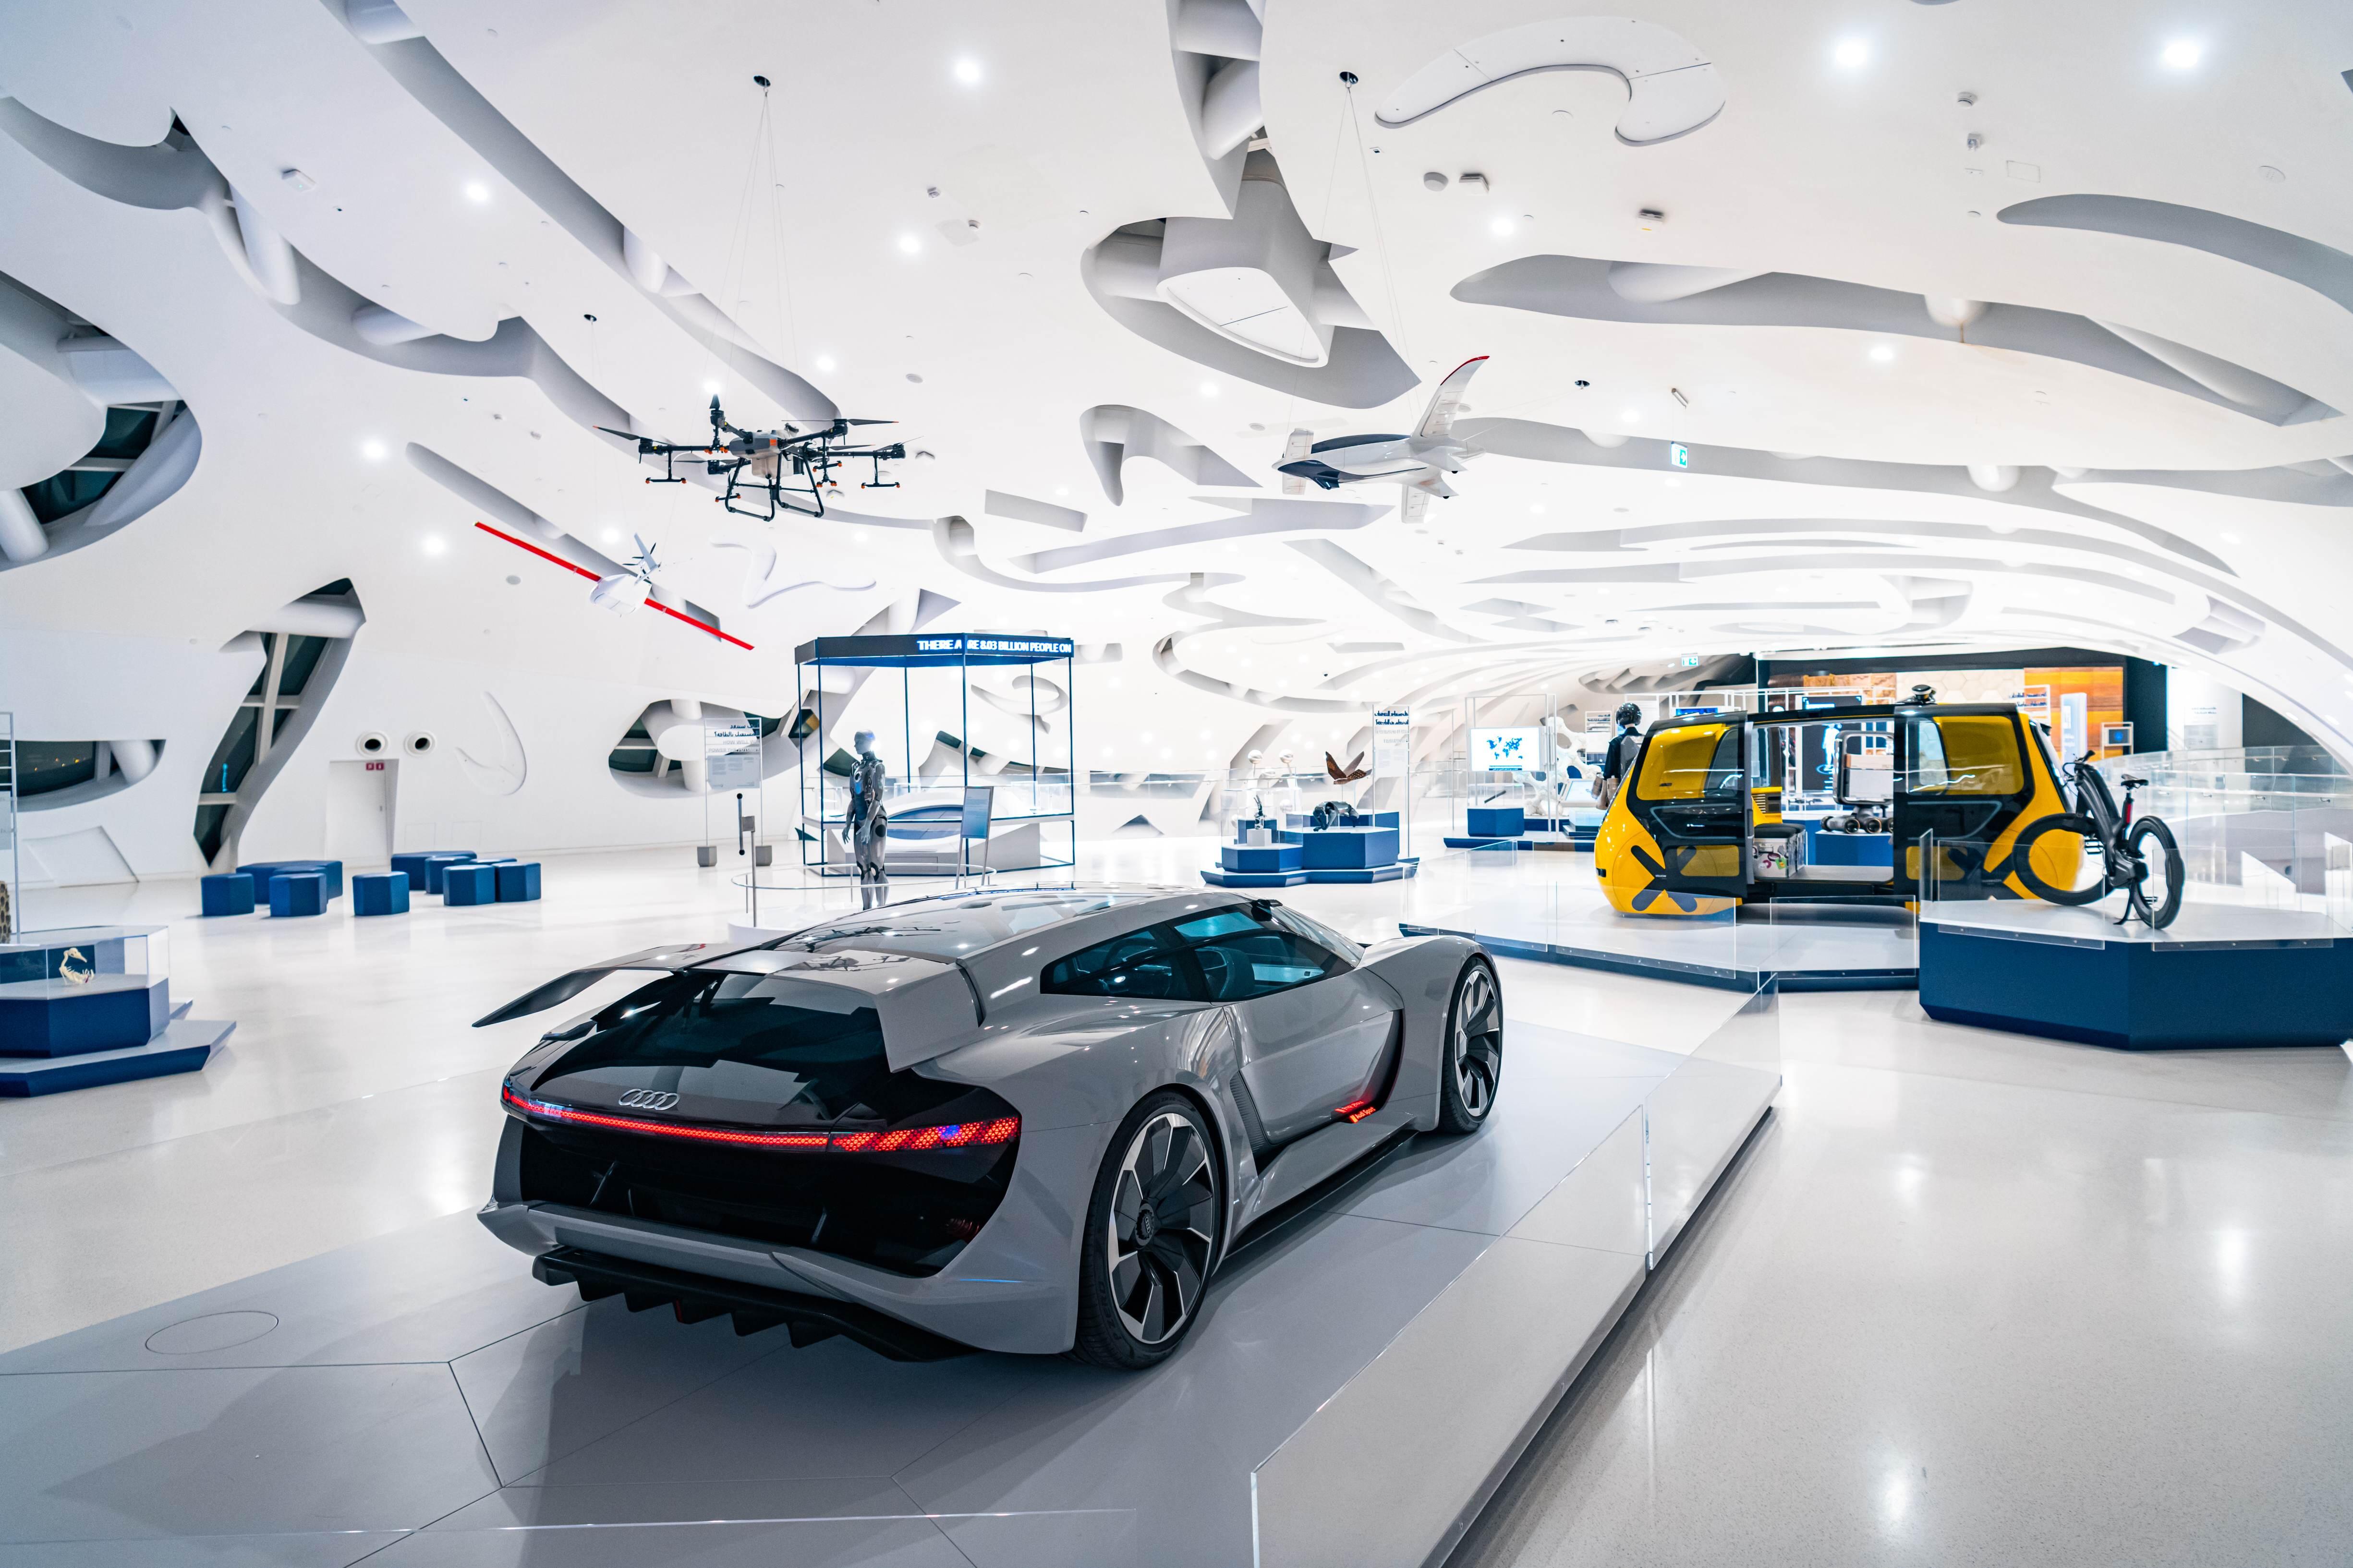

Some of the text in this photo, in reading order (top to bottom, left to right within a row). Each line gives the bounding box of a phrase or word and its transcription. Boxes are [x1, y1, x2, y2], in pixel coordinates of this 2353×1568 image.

[917, 639, 954, 651] THERE
[998, 640, 1030, 652] BILLION
[1030, 641, 1059, 653] PEOPLE
[1059, 643, 1072, 653] ON
[1355, 1106, 1376, 1119] Audi Sport
